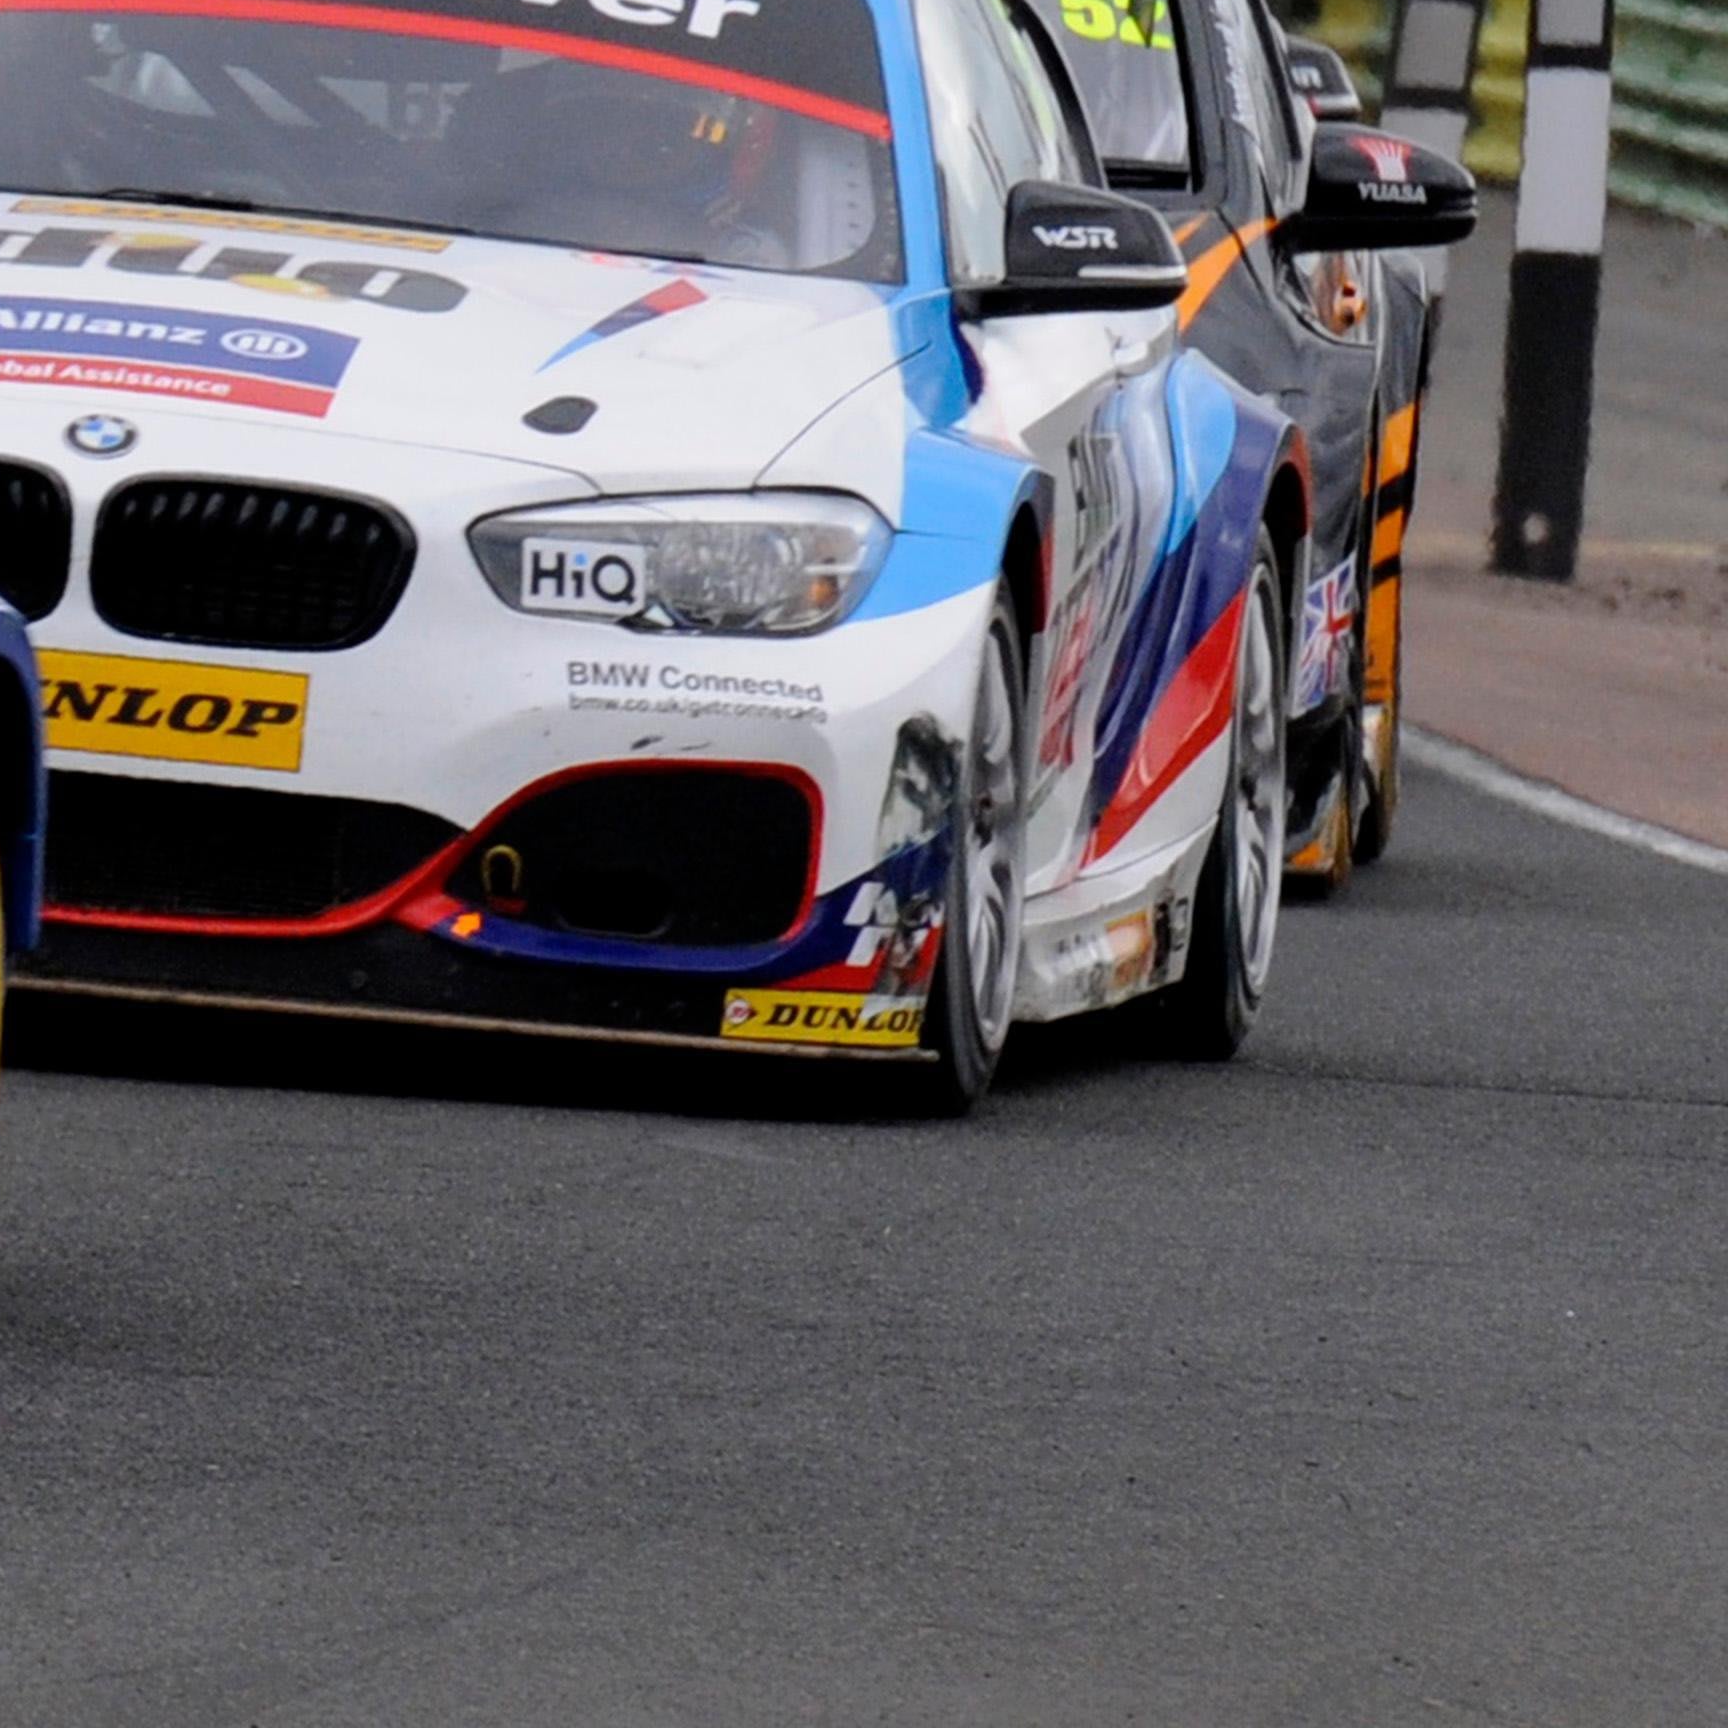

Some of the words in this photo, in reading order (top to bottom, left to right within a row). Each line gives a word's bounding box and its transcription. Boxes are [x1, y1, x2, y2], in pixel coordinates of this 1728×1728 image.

[59, 361, 234, 398] Assistance
[529, 549, 637, 607] HiQ
[566, 659, 651, 689] BMW
[658, 664, 824, 704] Connected
